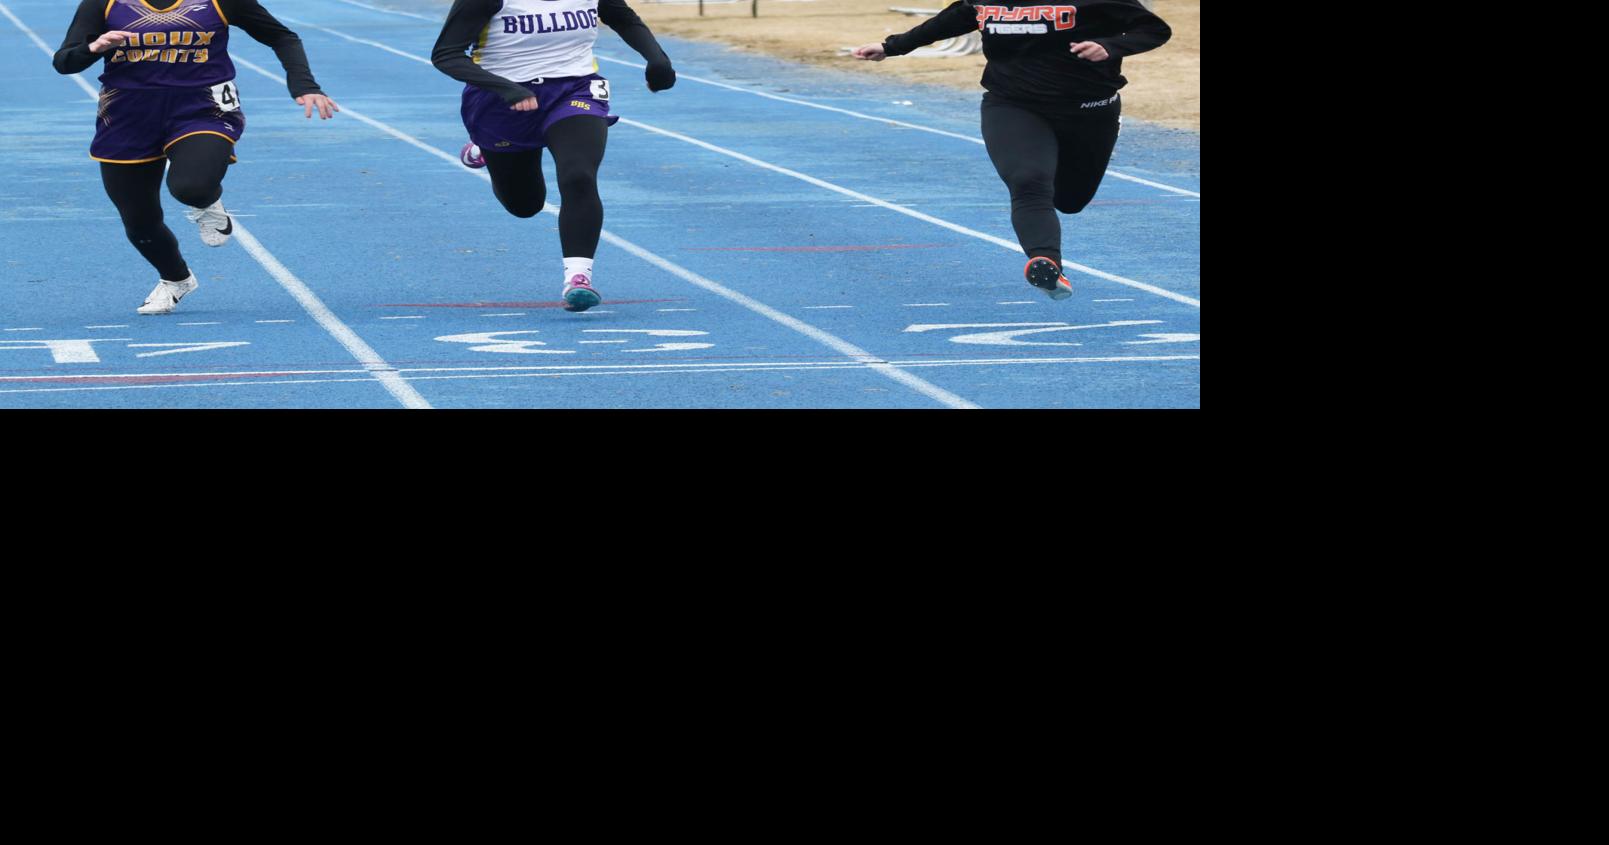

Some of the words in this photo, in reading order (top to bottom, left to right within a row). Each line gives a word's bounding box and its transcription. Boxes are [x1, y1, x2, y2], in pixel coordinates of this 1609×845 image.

[986, 23, 1048, 34] TIGERS
[116, 30, 216, 47] IOUX
[221, 84, 236, 107] 4
[598, 80, 609, 99] 3
[1080, 98, 1109, 109] NIKE
